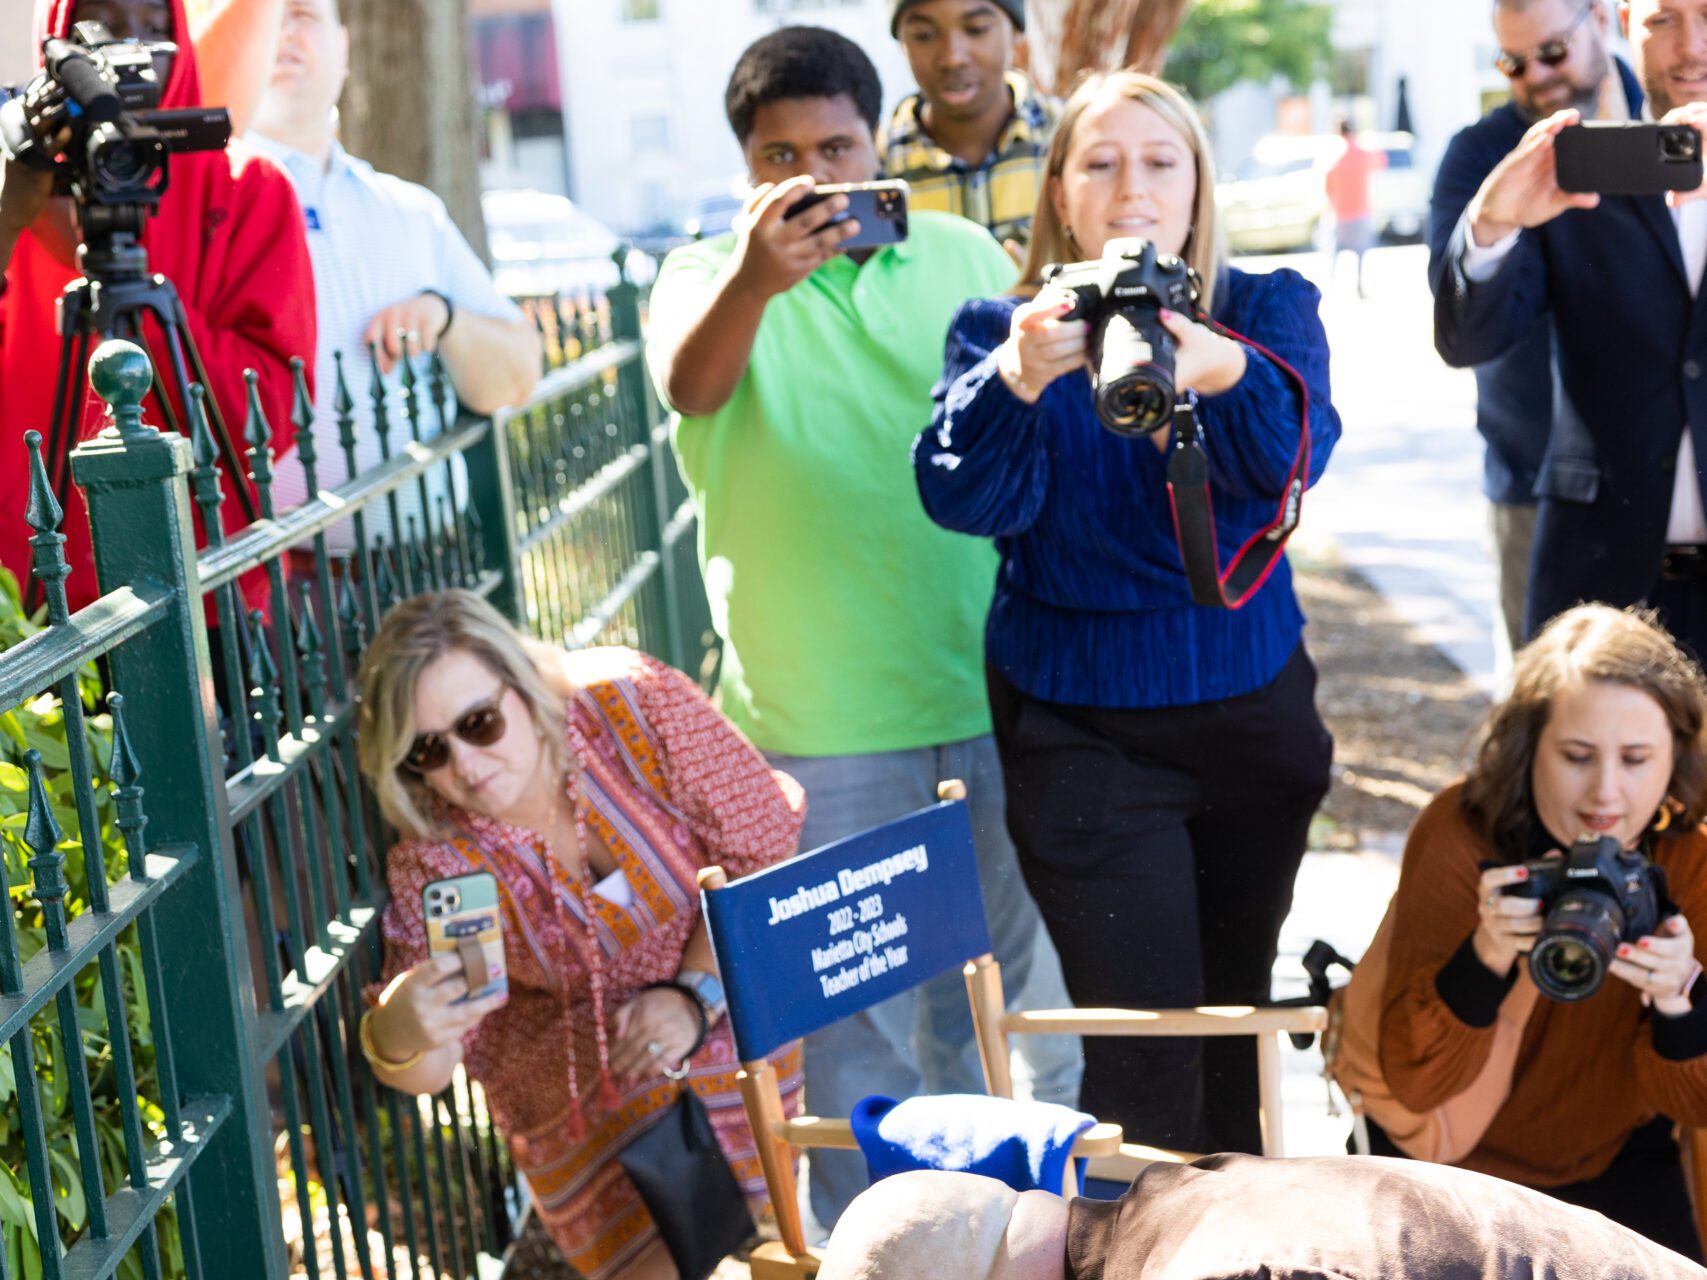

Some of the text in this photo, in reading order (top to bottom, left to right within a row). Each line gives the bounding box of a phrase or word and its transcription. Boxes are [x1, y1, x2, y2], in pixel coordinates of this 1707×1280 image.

[768, 844, 929, 926] Joshua Dempsey
[811, 912, 909, 973] Marietta City Schools
[819, 945, 909, 999] Teacher of the Year
